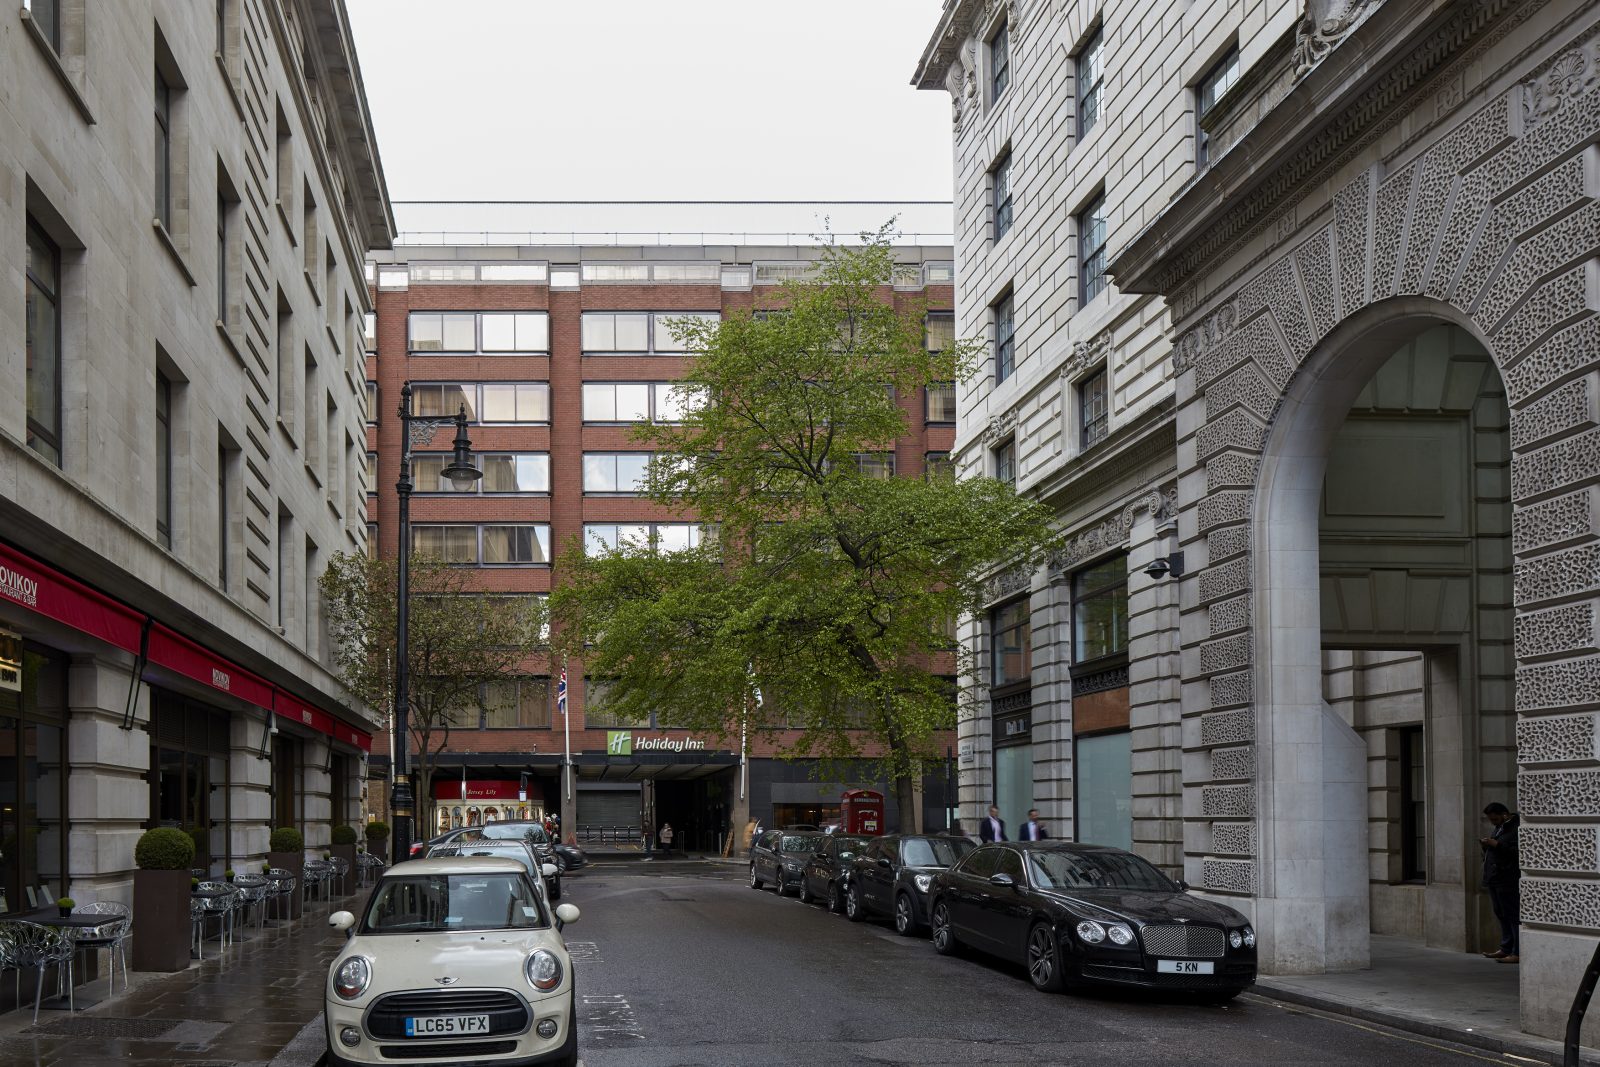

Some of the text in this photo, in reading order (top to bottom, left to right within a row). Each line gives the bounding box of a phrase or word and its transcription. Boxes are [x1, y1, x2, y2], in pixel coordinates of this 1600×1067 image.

[0, 566, 37, 597] OVIKOV
[636, 736, 705, 753] Holiday Inn
[1176, 962, 1198, 972] 5 KN
[416, 1016, 487, 1033] LC65 VFX
